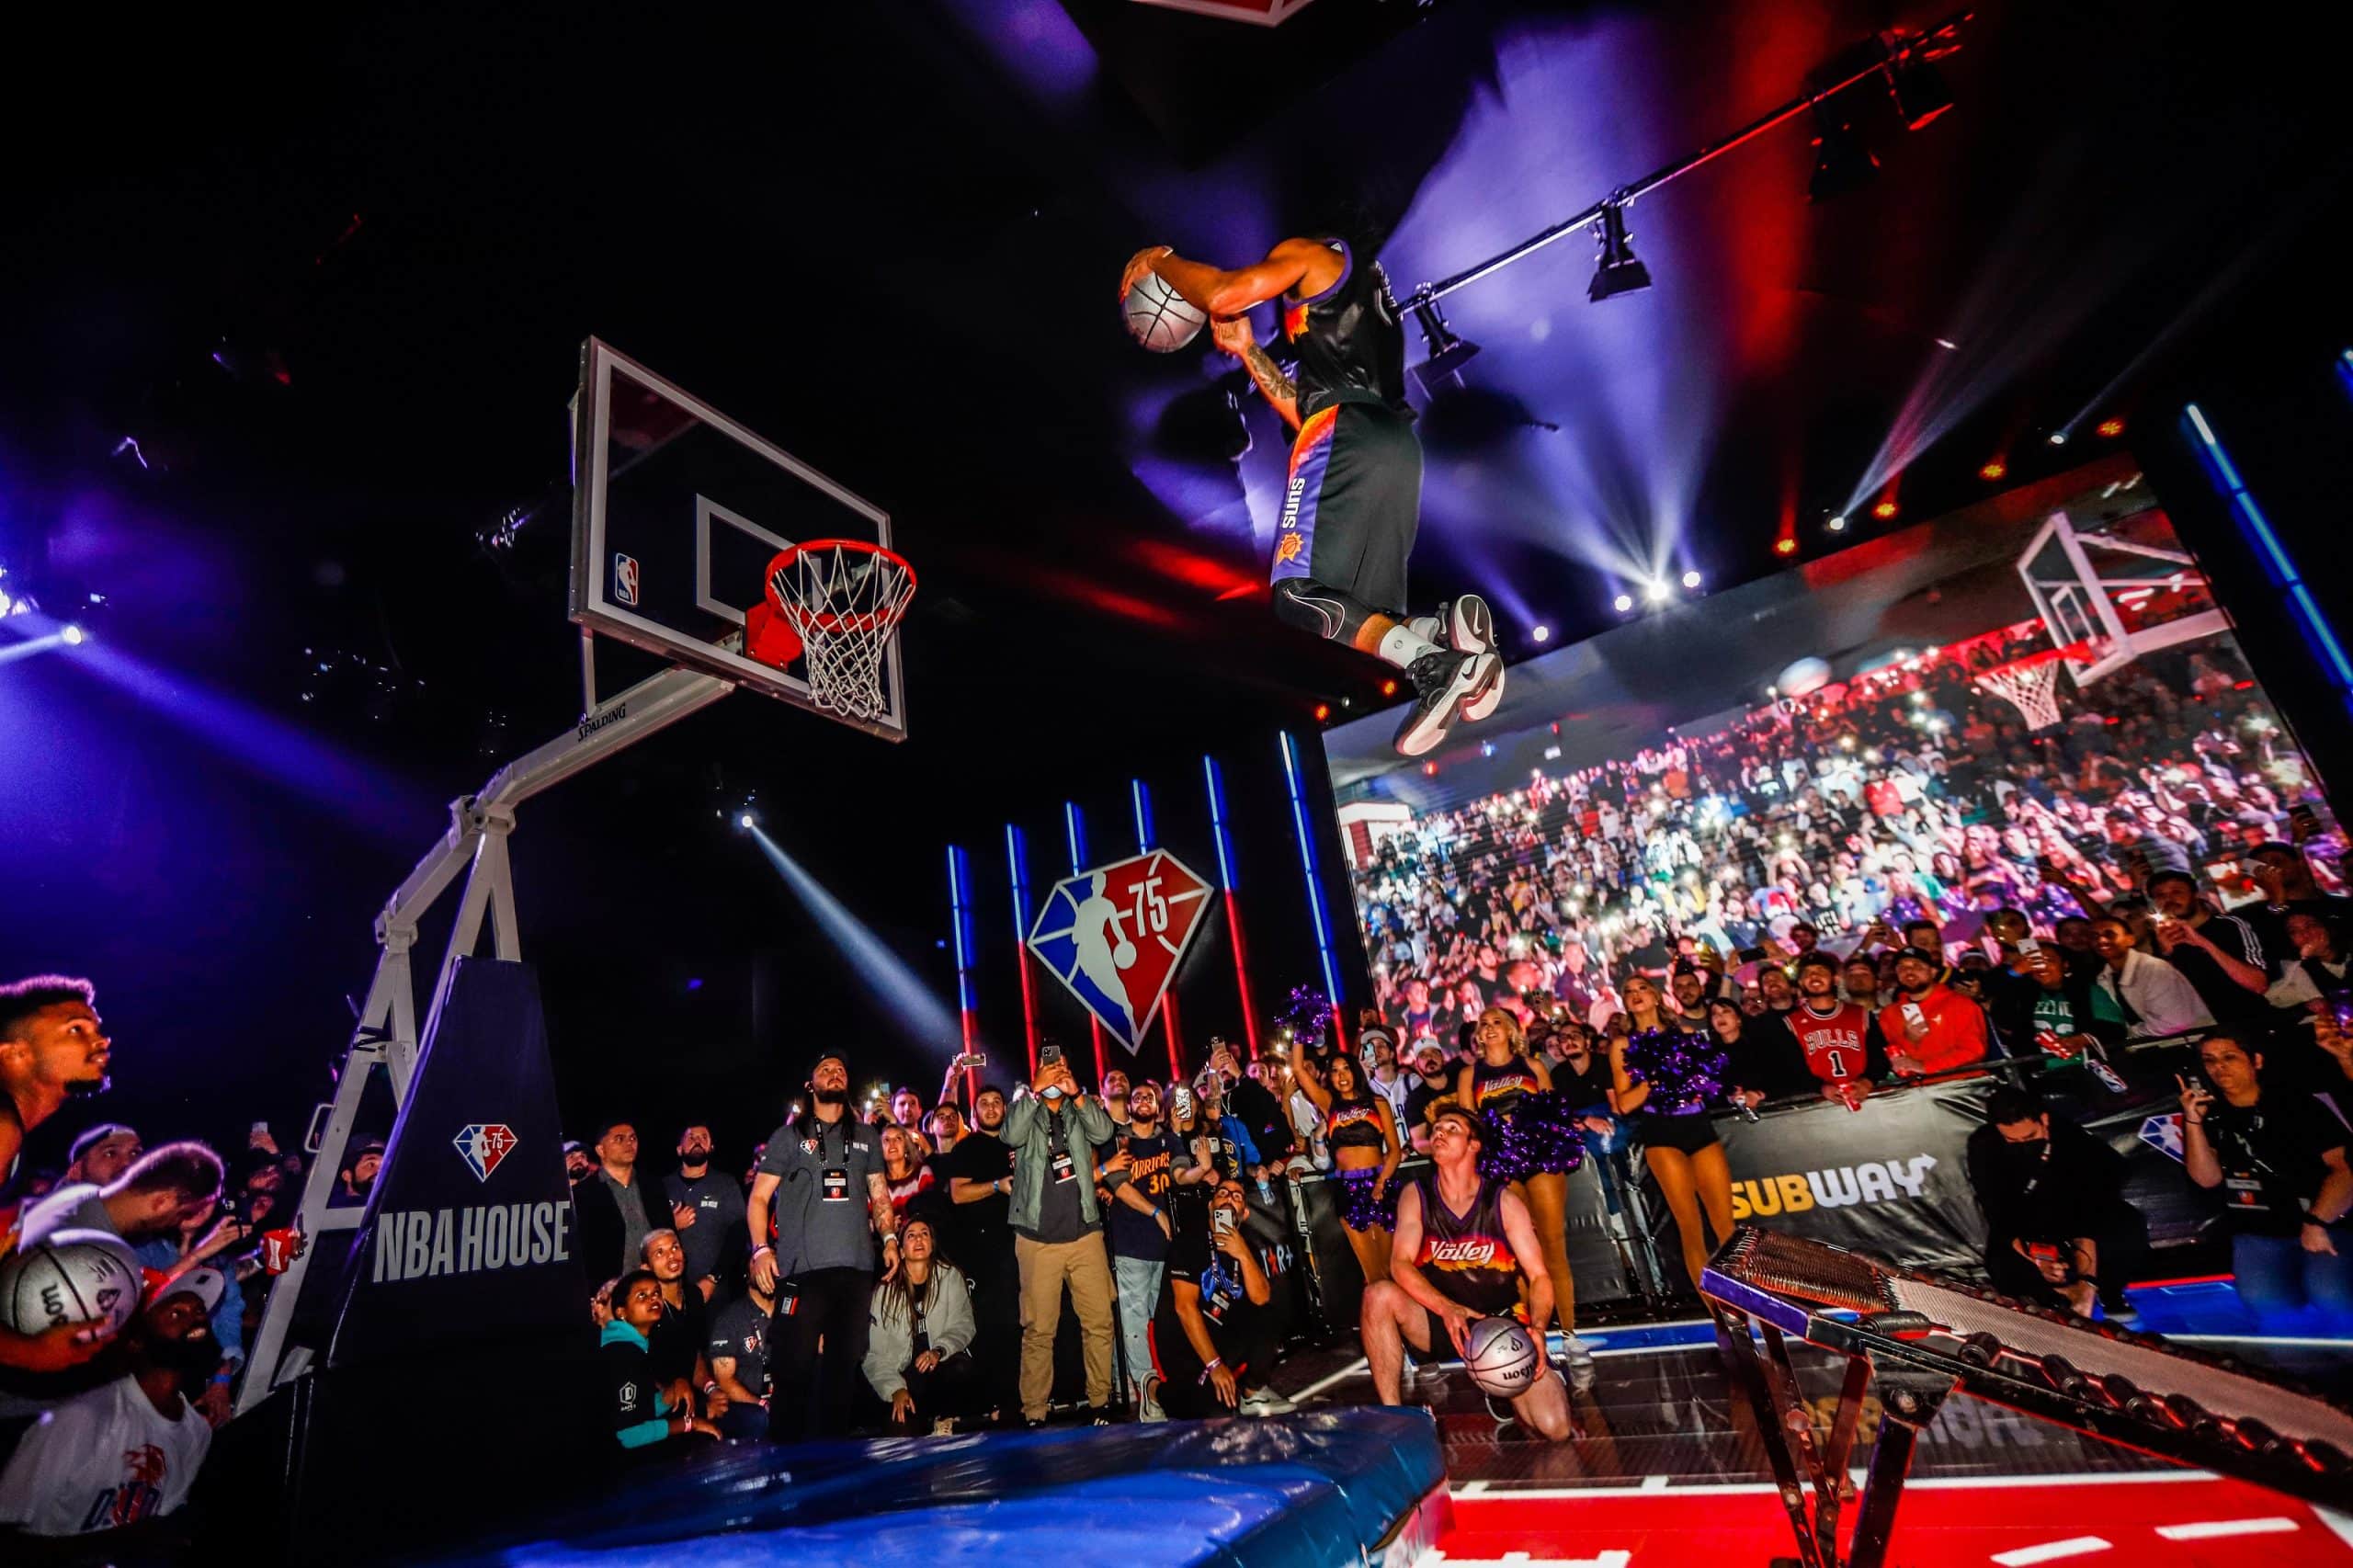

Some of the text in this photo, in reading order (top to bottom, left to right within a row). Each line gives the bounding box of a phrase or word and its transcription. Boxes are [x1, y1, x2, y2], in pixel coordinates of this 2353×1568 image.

[1281, 477, 1306, 529] SUNS
[577, 701, 627, 743] SPALDING
[1128, 876, 1168, 937] 75
[1827, 1050, 1847, 1077] 1
[492, 1132, 505, 1150] 75
[1732, 1153, 1938, 1220] SUBWAY
[373, 1200, 571, 1283] NBA HOUSE
[1430, 1241, 1494, 1264] Valley
